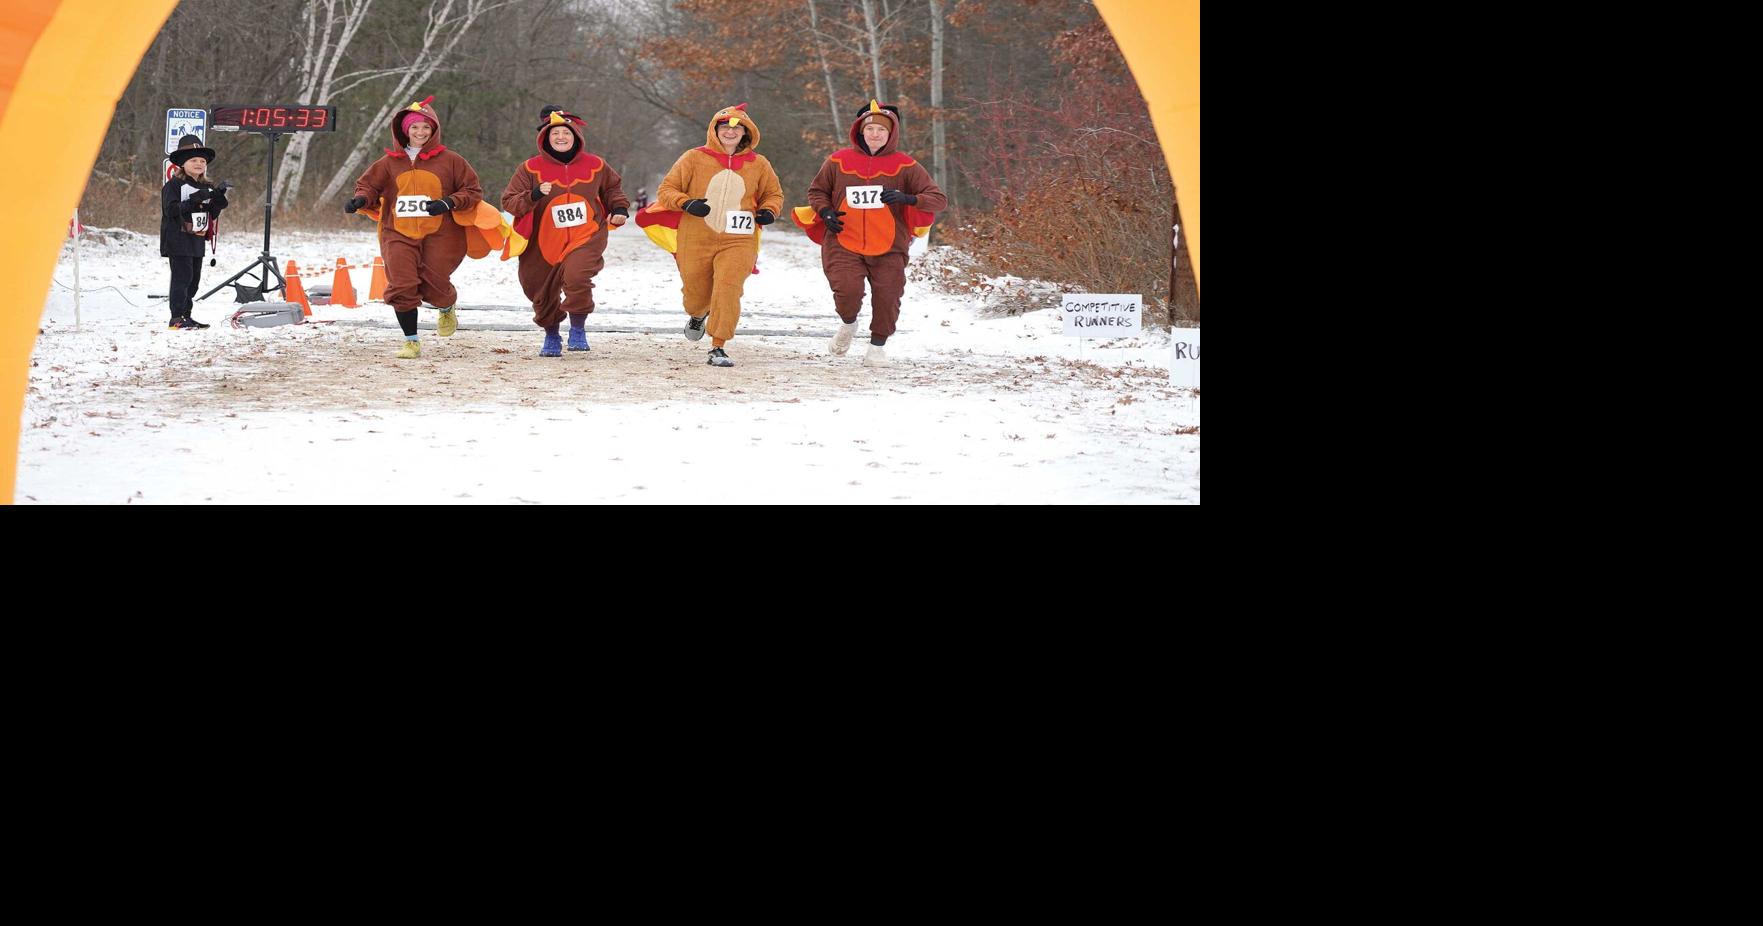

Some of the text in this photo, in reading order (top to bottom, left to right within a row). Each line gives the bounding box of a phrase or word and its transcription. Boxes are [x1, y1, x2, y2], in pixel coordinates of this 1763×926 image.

[173, 110, 200, 118] NOTICE
[852, 190, 878, 204] 317
[397, 200, 428, 212] 250
[557, 206, 583, 223] 884
[731, 215, 752, 229] 172
[1065, 302, 1136, 313] COMPETITIVE
[1074, 315, 1132, 328] RUNNERS
